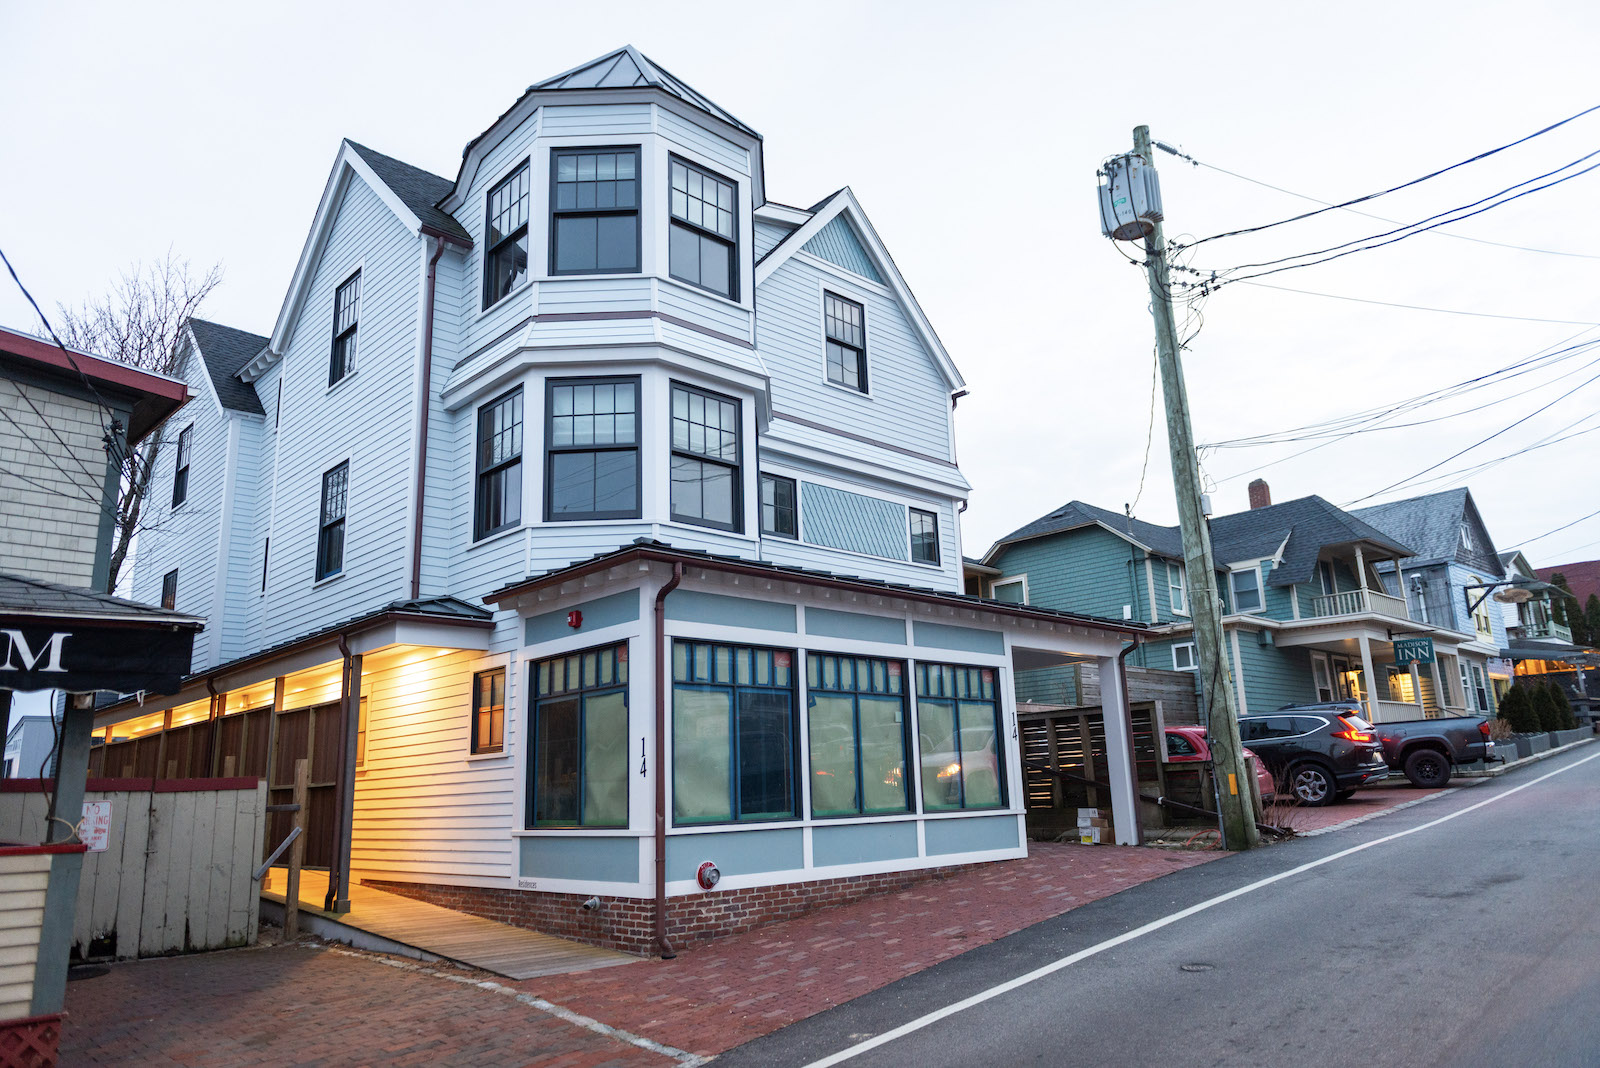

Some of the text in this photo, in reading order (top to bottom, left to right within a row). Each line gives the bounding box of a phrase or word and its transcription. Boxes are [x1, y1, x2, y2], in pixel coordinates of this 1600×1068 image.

[1397, 640, 1429, 648] MADISON
[1398, 646, 1430, 660] INN
[1011, 712, 1018, 741] 14
[639, 737, 648, 777] 14
[86, 805, 101, 815] NO
[518, 879, 538, 889] Residences
